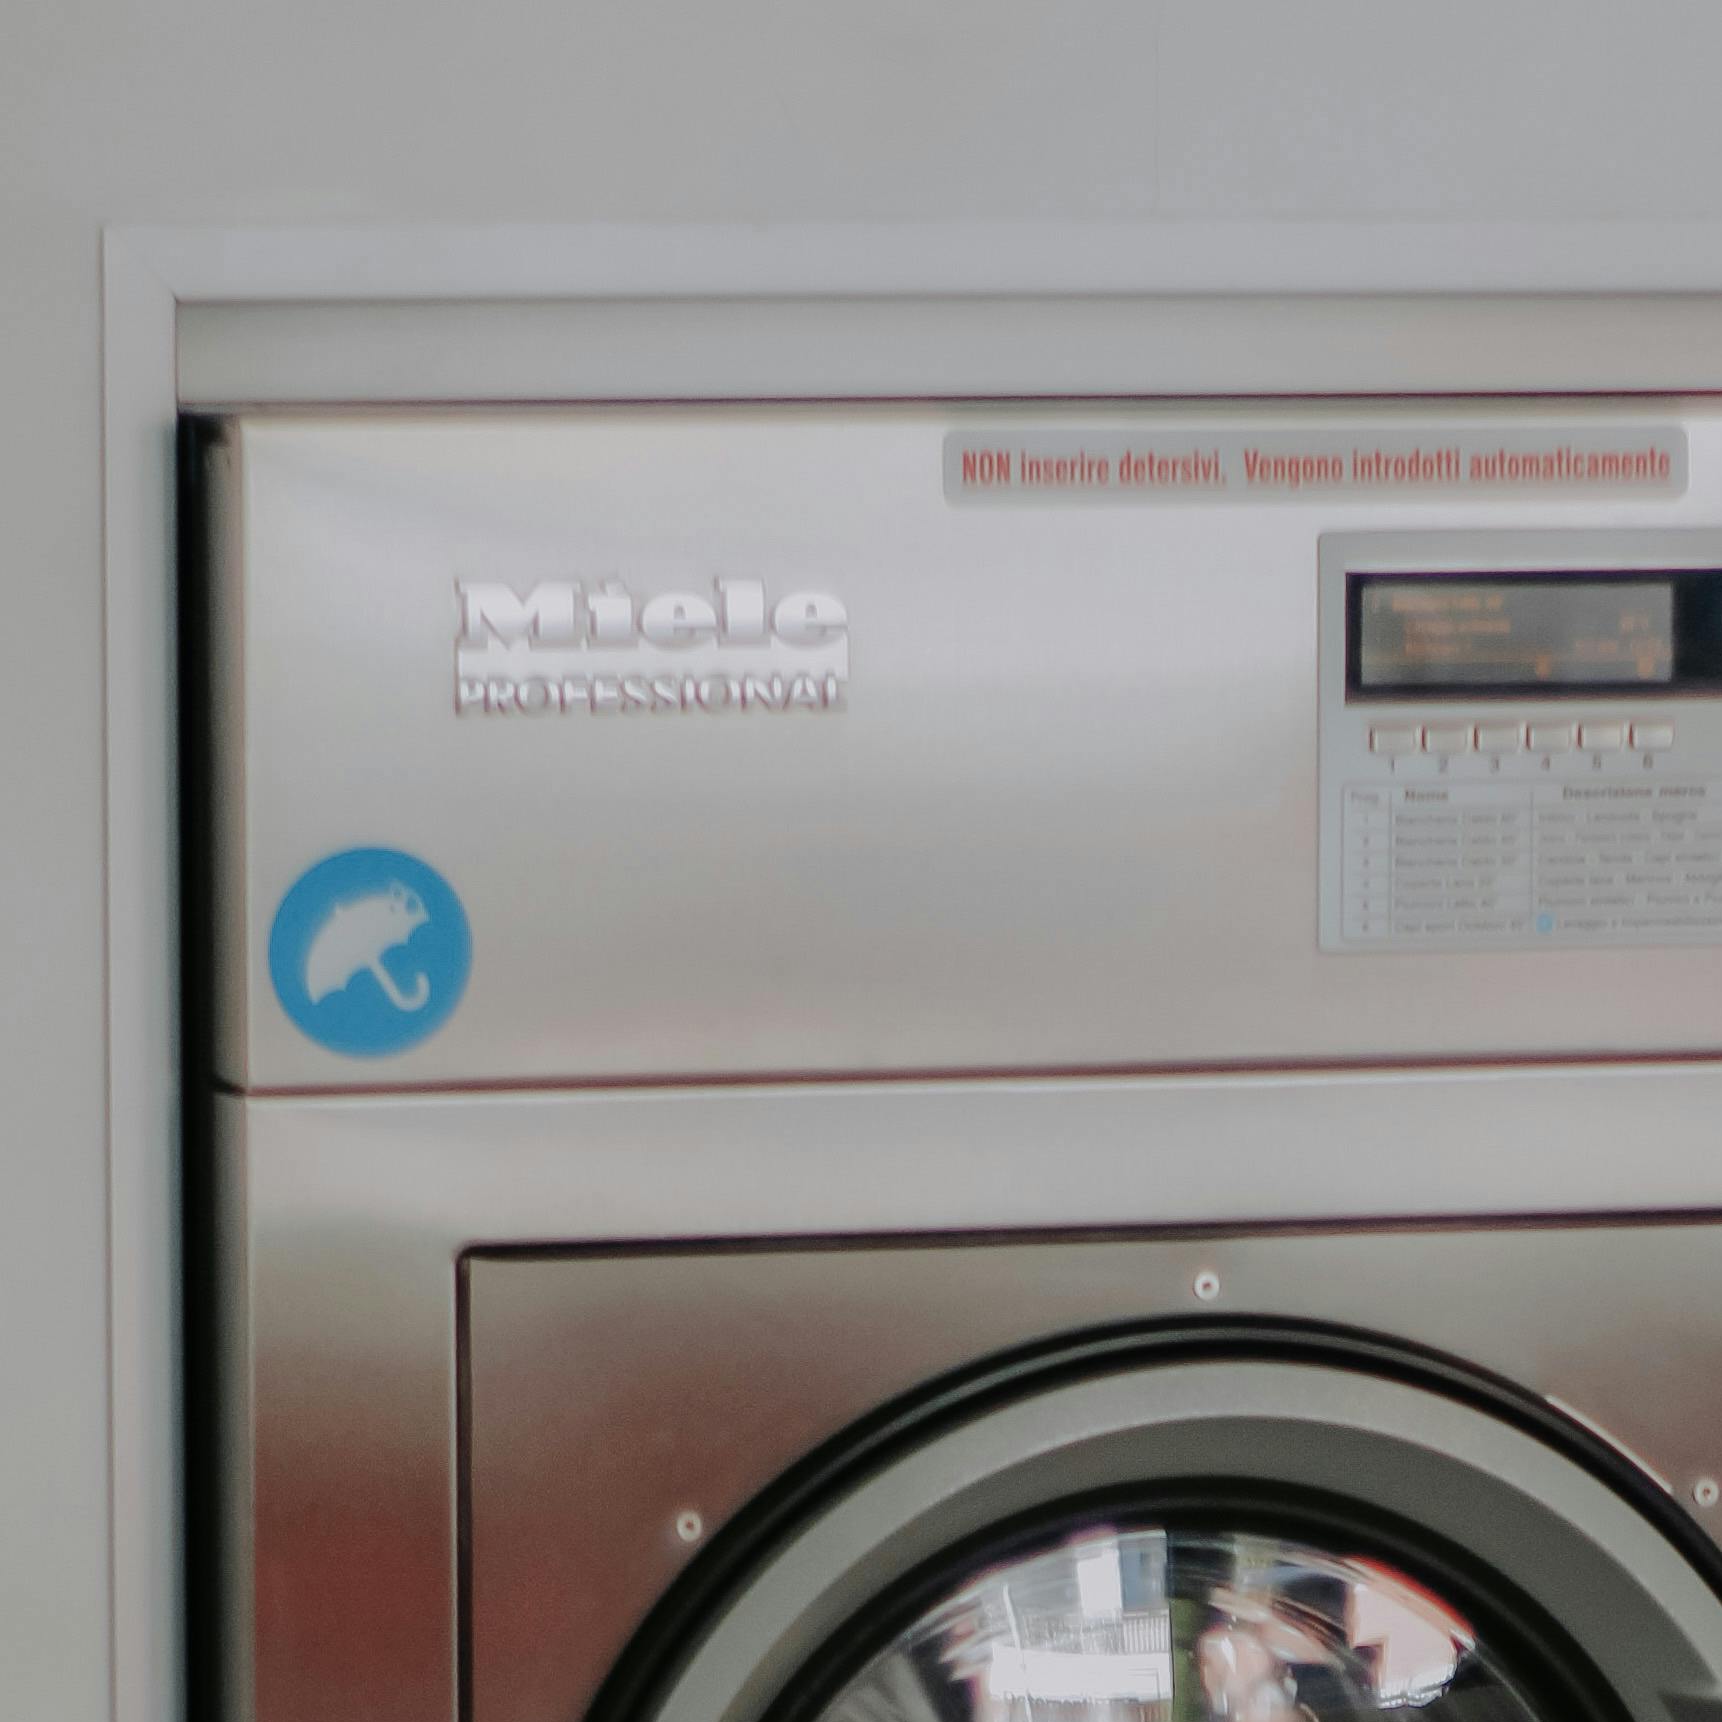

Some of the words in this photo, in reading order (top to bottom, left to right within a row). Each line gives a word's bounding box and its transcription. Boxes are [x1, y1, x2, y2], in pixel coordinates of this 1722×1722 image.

[962, 450, 1011, 485] NON
[1020, 450, 1109, 485] inserire
[1243, 448, 1344, 488] Vengono
[1351, 447, 1461, 483] introdotti
[1469, 445, 1671, 483] automaticamente
[455, 576, 849, 650] Miele
[455, 673, 848, 716] PROFESSIONAL
